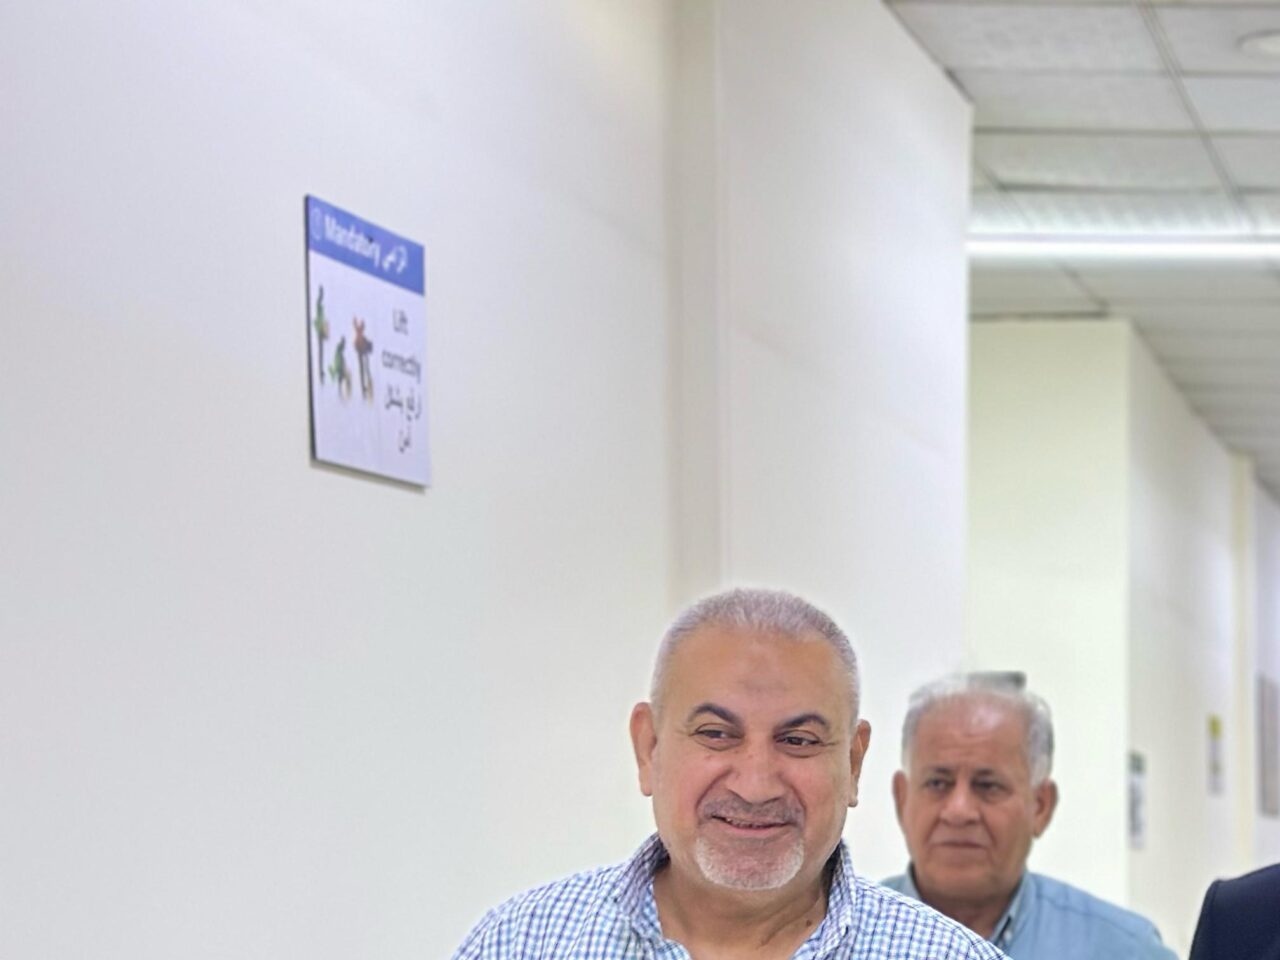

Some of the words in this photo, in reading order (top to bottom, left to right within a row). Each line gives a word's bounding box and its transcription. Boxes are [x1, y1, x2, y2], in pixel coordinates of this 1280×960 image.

[324, 214, 380, 268] Mandatory
[393, 308, 408, 336] Lift
[382, 349, 421, 384] correctly
